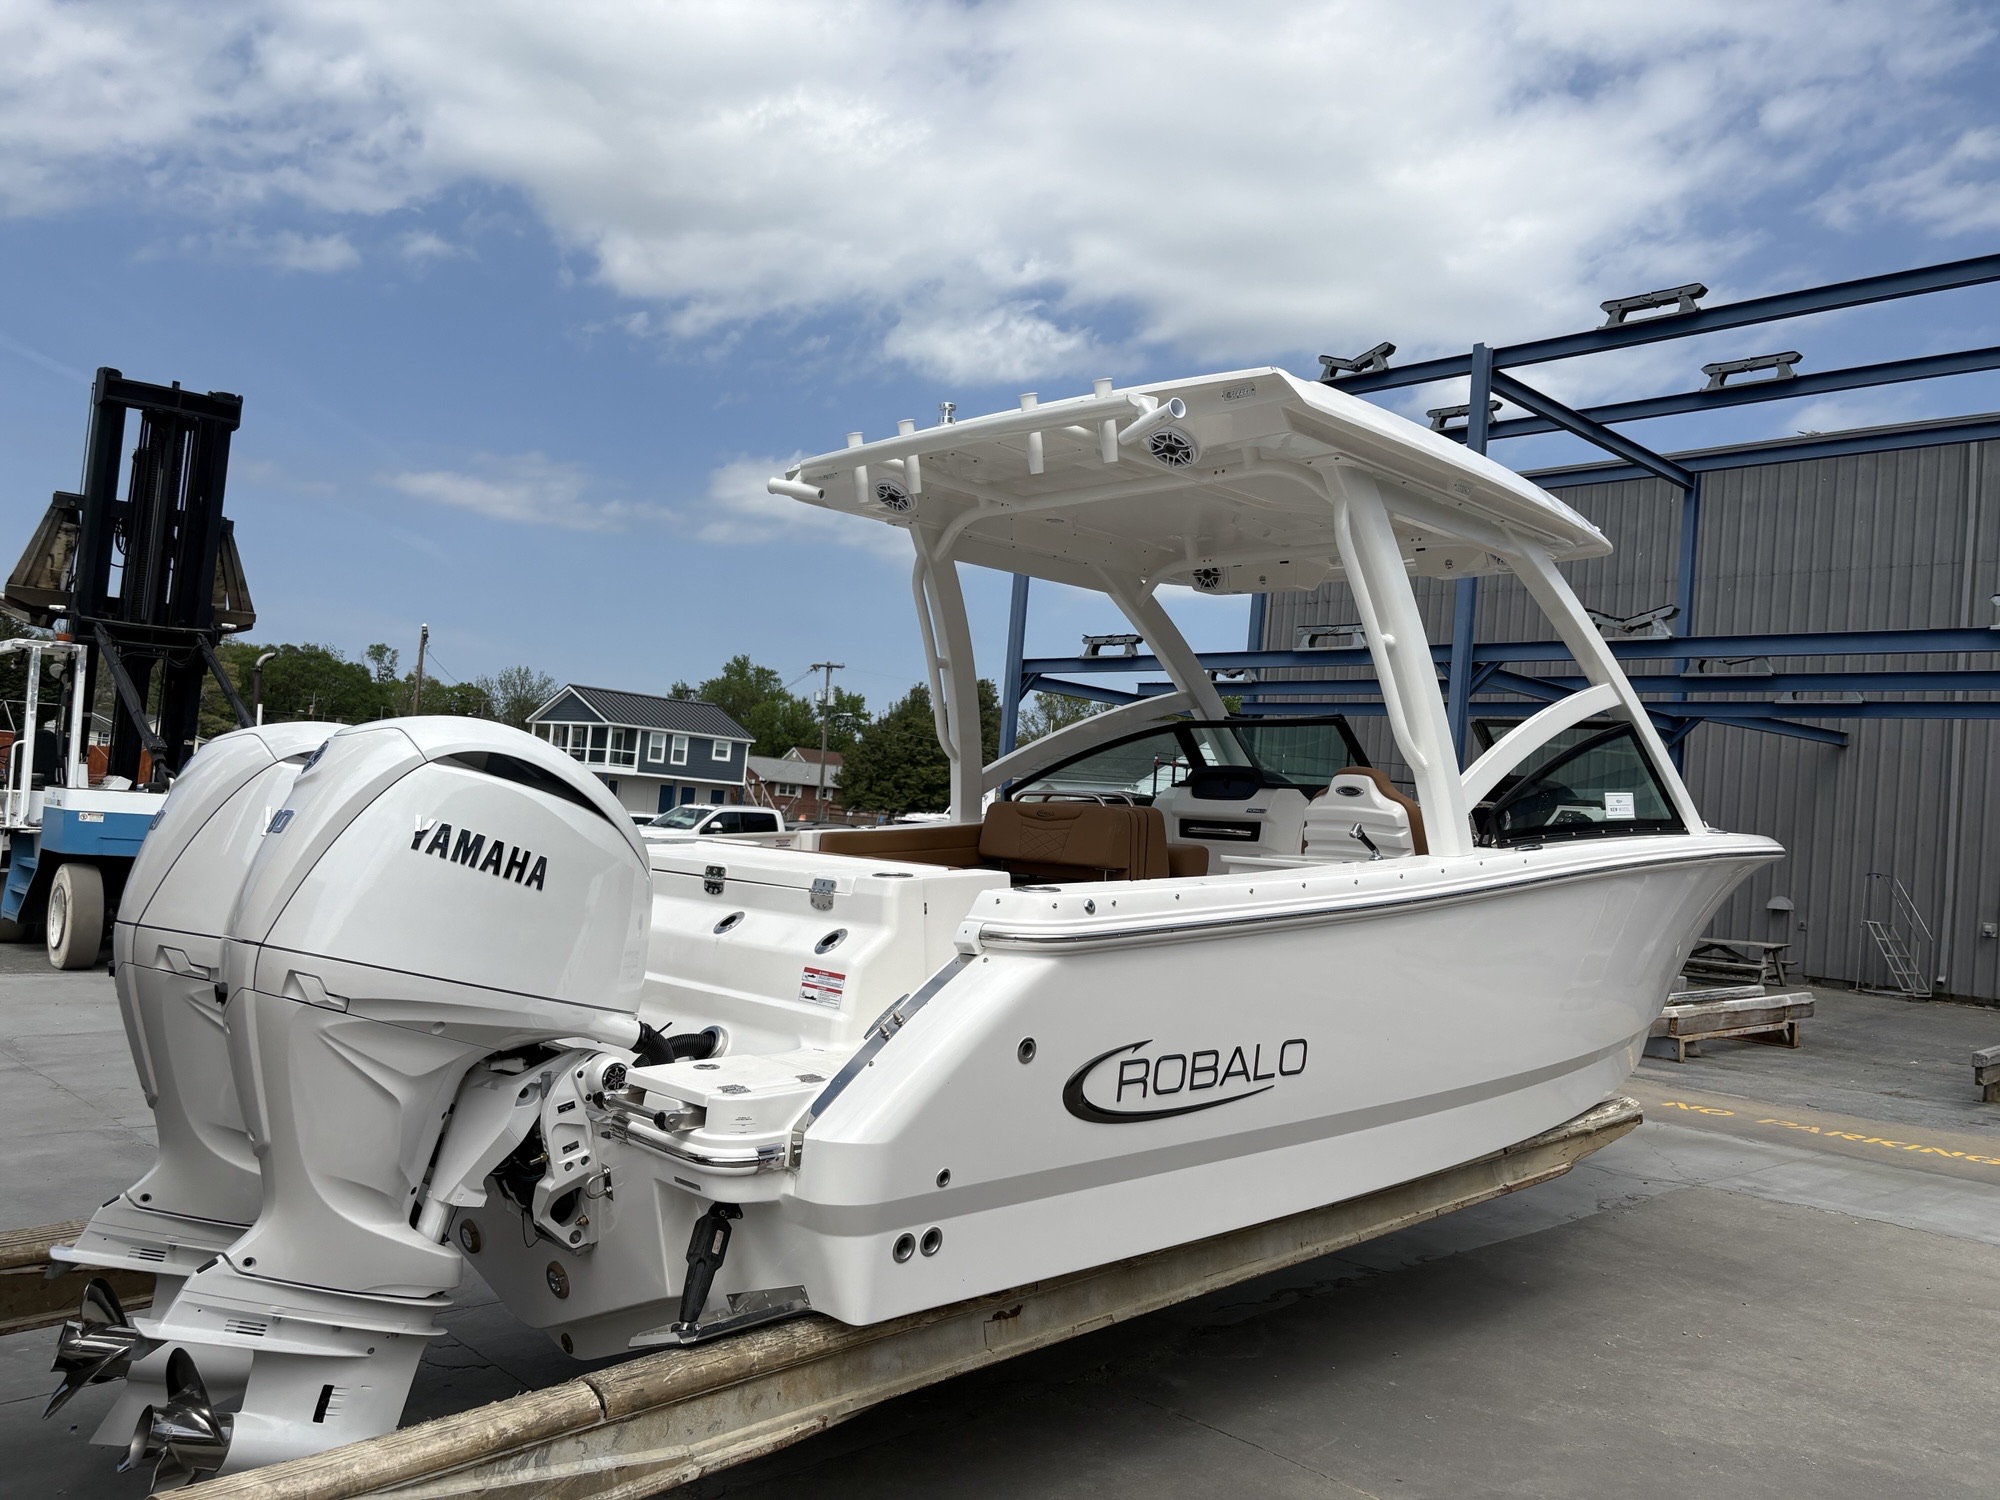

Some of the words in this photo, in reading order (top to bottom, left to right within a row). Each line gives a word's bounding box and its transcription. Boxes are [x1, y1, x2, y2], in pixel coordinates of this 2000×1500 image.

[410, 813, 548, 892] YAMAHA
[1116, 1038, 1308, 1103] ROBALO
[1661, 1102, 1735, 1117] NO
[1755, 1118, 2000, 1165] PARKING
